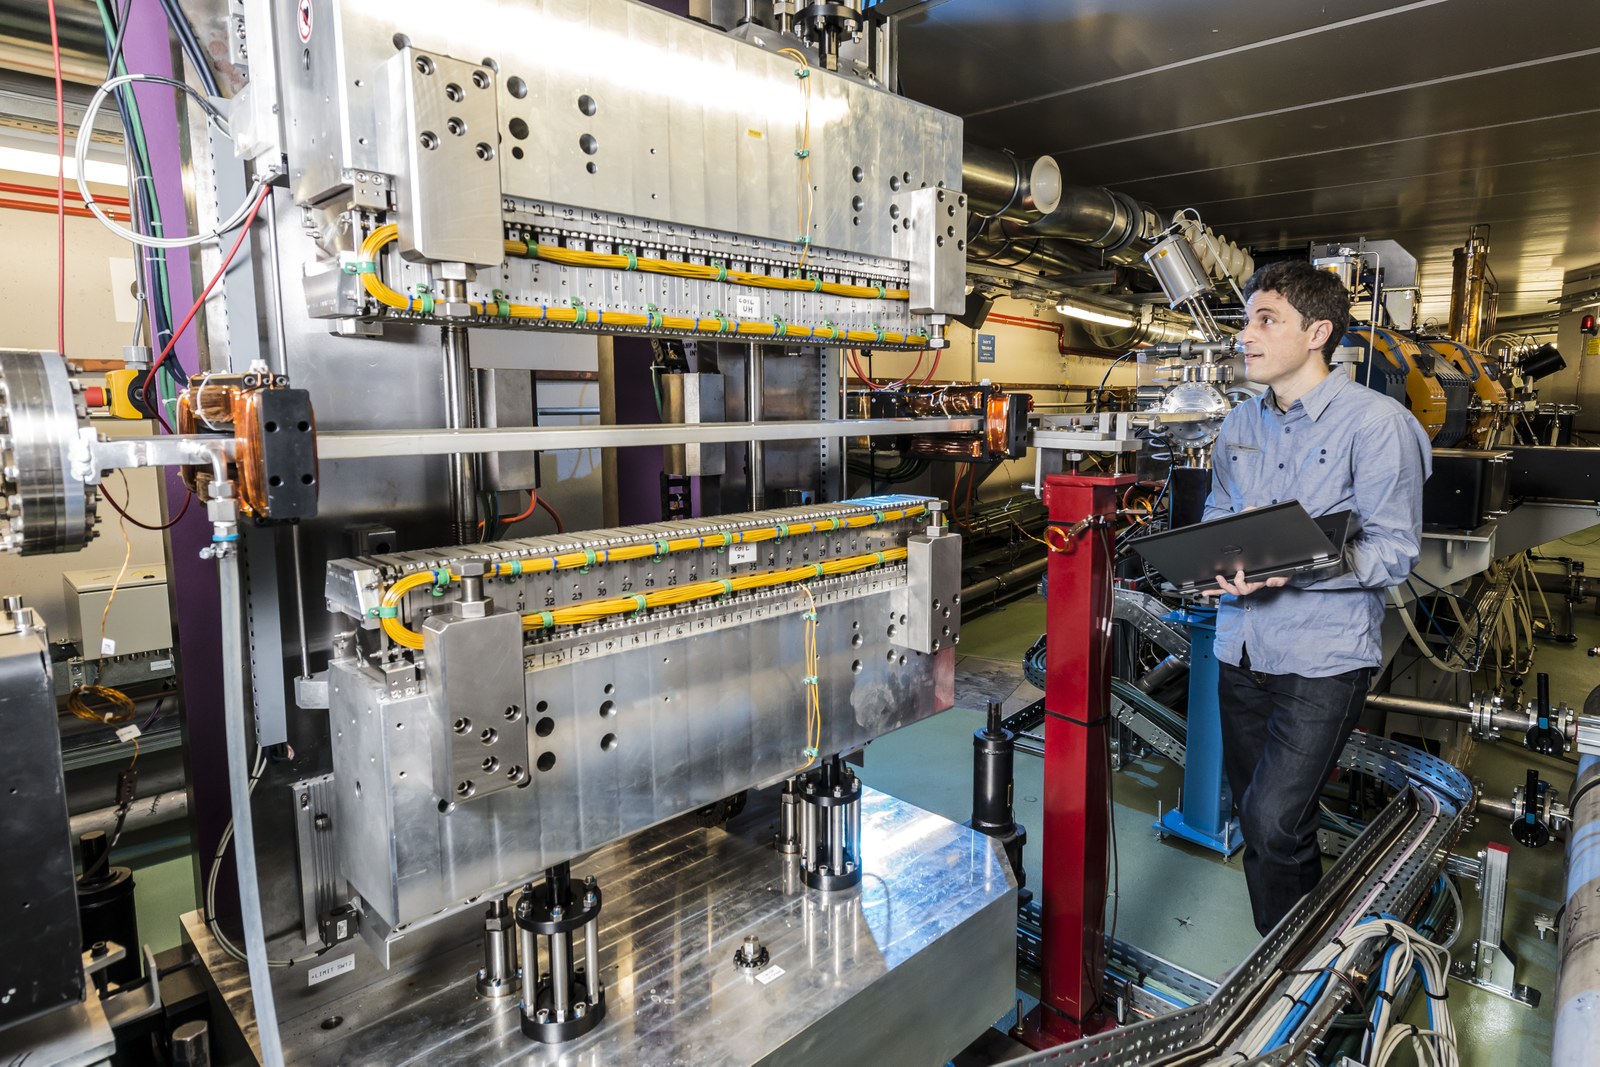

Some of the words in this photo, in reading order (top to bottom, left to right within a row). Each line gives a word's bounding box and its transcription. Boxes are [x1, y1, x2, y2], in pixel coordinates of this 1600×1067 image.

[516, 602, 525, 611] 31
[544, 597, 555, 606] 32
[572, 592, 583, 600] 29
[597, 588, 607, 596] 30
[622, 582, 632, 592] 27
[668, 576, 677, 585] 25
[689, 573, 697, 581] 26
